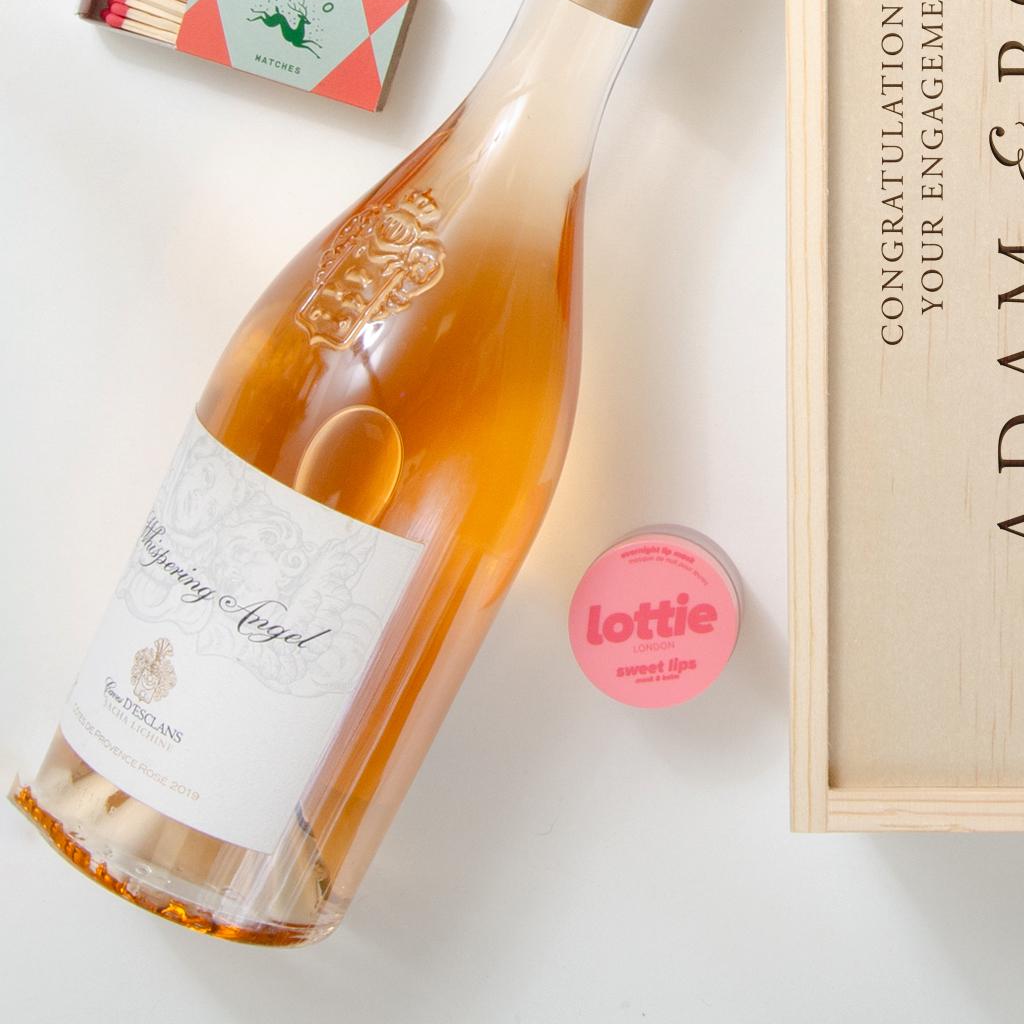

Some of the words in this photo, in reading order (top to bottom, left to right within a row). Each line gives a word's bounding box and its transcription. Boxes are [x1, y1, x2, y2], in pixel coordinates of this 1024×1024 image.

[255, 54, 301, 75] MATCHES
[921, 216, 944, 316] YOUR
[139, 513, 216, 604] Whispering
[219, 595, 332, 649] Angel
[586, 592, 718, 645] lottie
[633, 641, 676, 653] LONDON
[616, 660, 664, 677] sweet
[668, 657, 697, 674] lips
[169, 781, 200, 801] 2019
